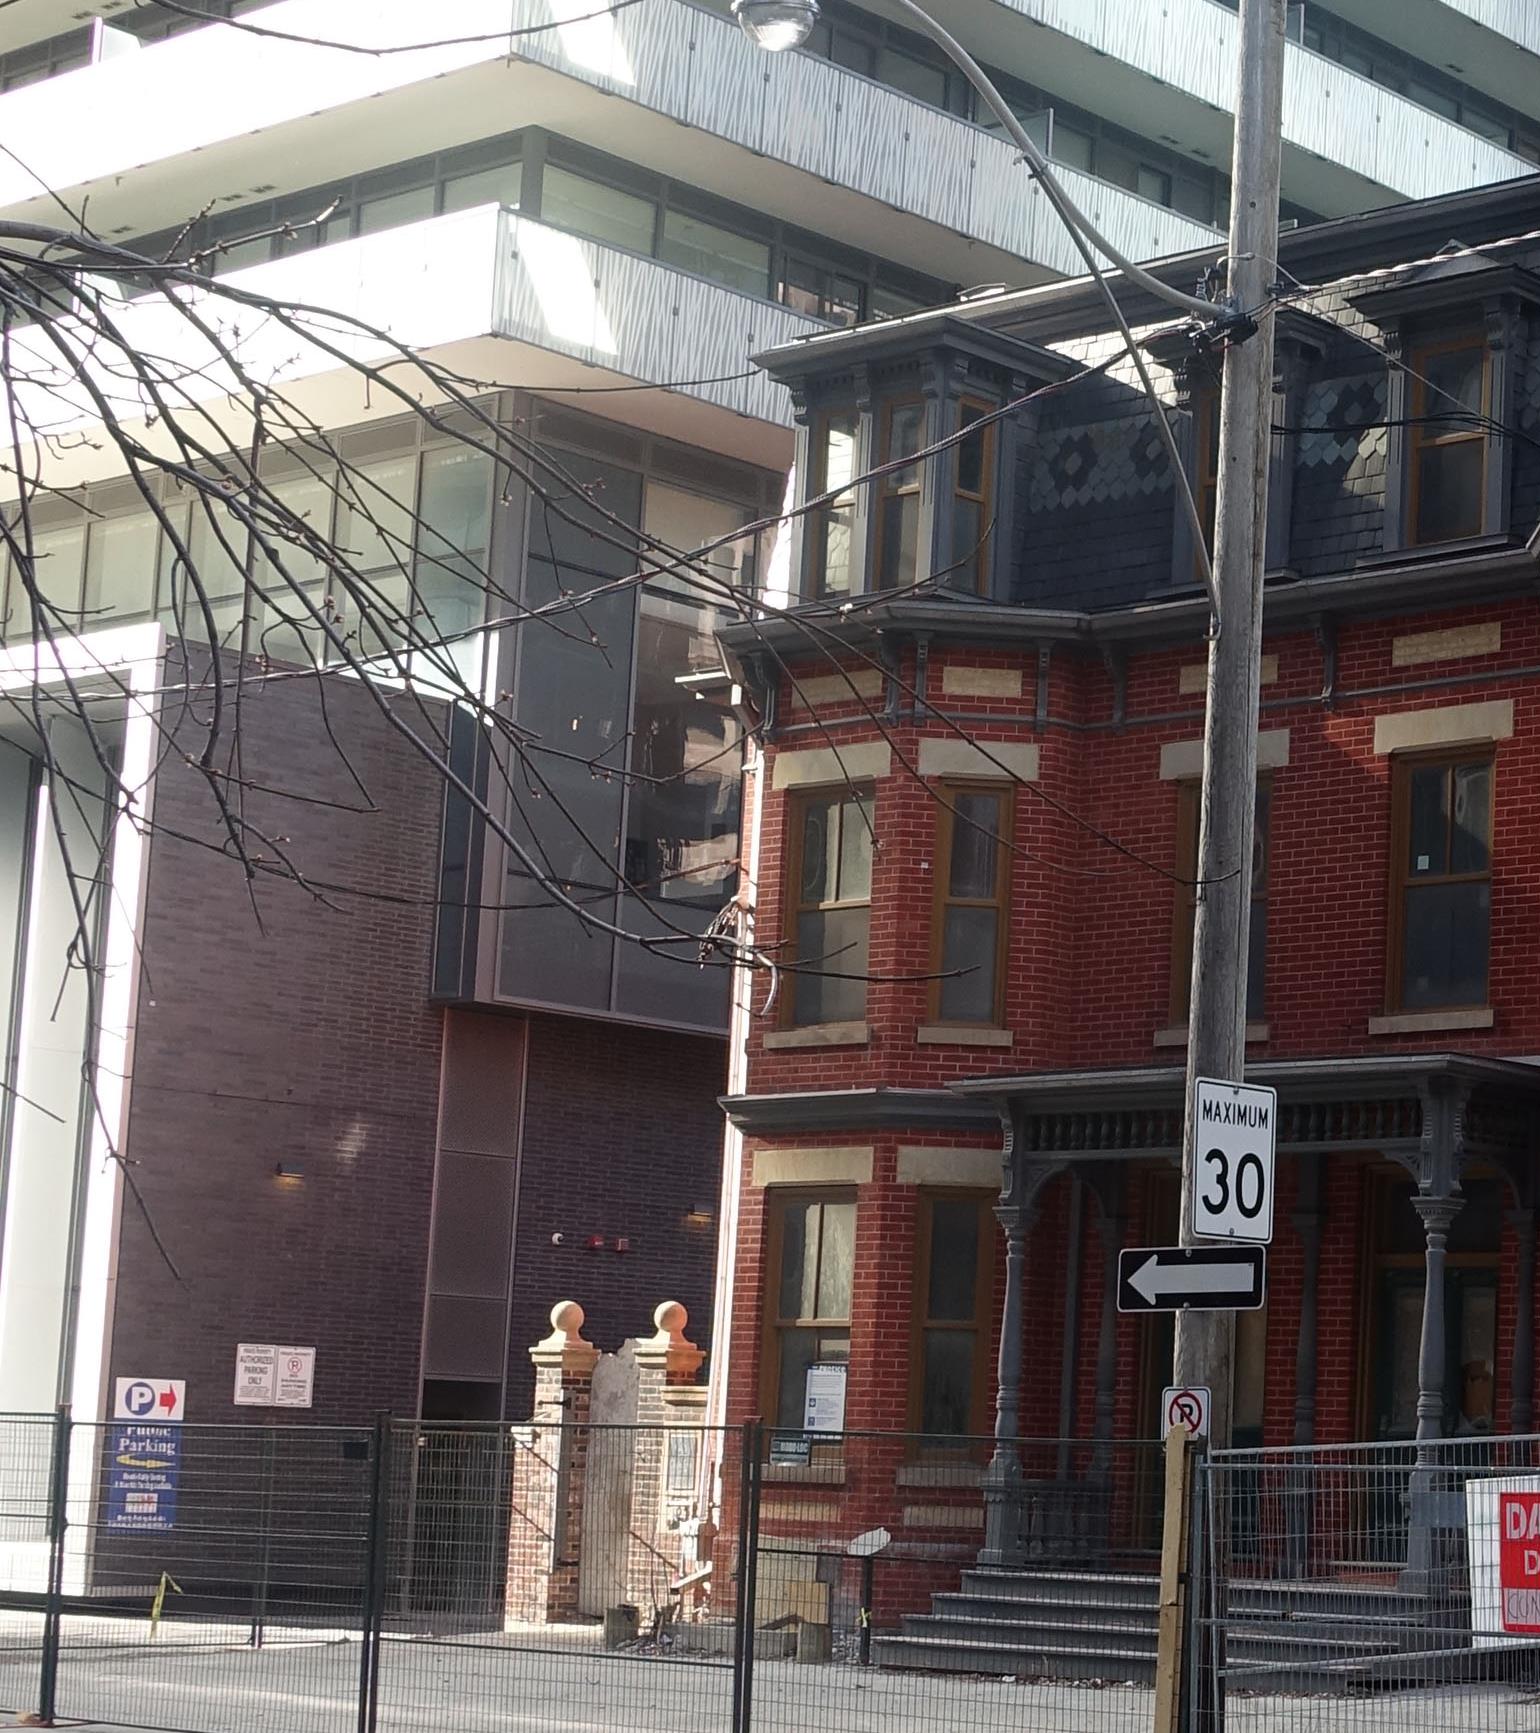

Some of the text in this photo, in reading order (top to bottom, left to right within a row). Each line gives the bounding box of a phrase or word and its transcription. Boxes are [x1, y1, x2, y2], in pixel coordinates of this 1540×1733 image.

[1202, 1099, 1268, 1129] MAXIMUM
[1202, 1148, 1265, 1218] 30
[244, 1365, 268, 1375] PARKING
[248, 1376, 262, 1385] ONLY
[131, 1386, 153, 1411] P
[119, 1438, 176, 1455] Parking
